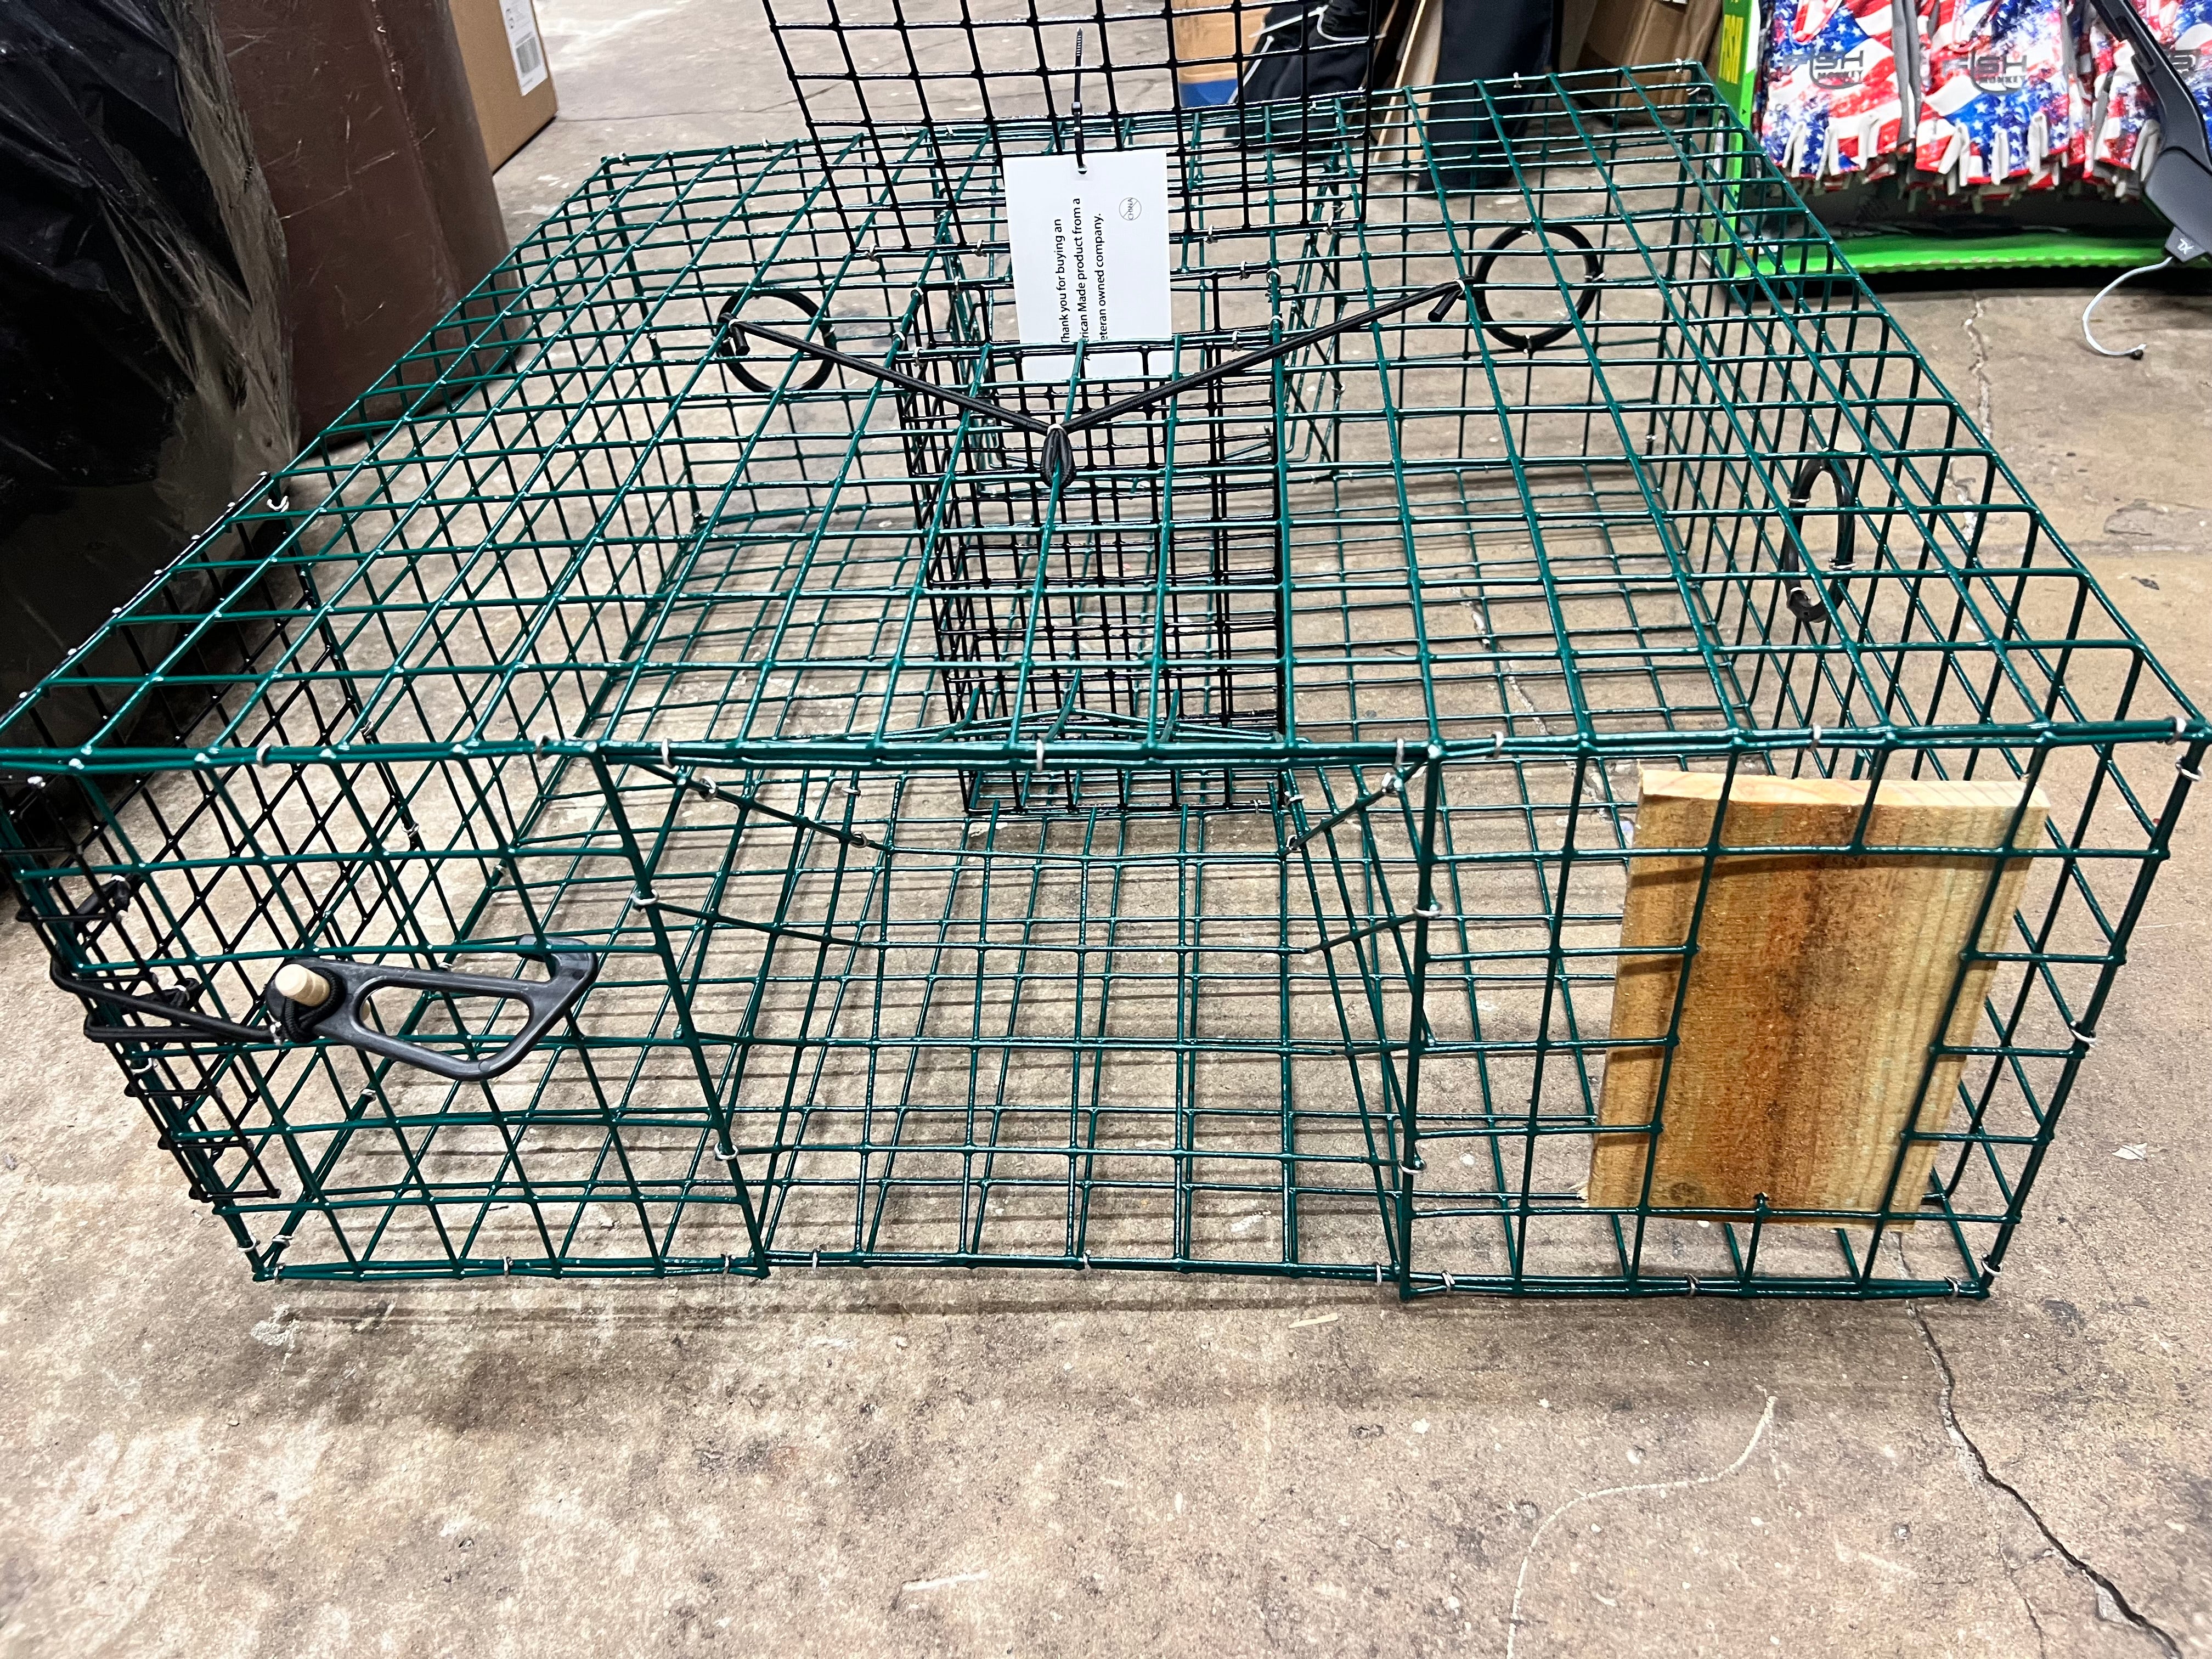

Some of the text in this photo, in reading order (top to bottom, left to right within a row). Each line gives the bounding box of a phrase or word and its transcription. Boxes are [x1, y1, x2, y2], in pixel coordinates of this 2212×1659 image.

[1054, 219, 1062, 233] an
[1072, 207, 1082, 234] from
[1054, 235, 1066, 274] buying
[1074, 236, 1087, 280] product
[1056, 275, 1066, 291] for
[1094, 213, 1108, 341] eteran owned company.
[1059, 293, 1070, 312] you
[1076, 282, 1087, 311] Made
